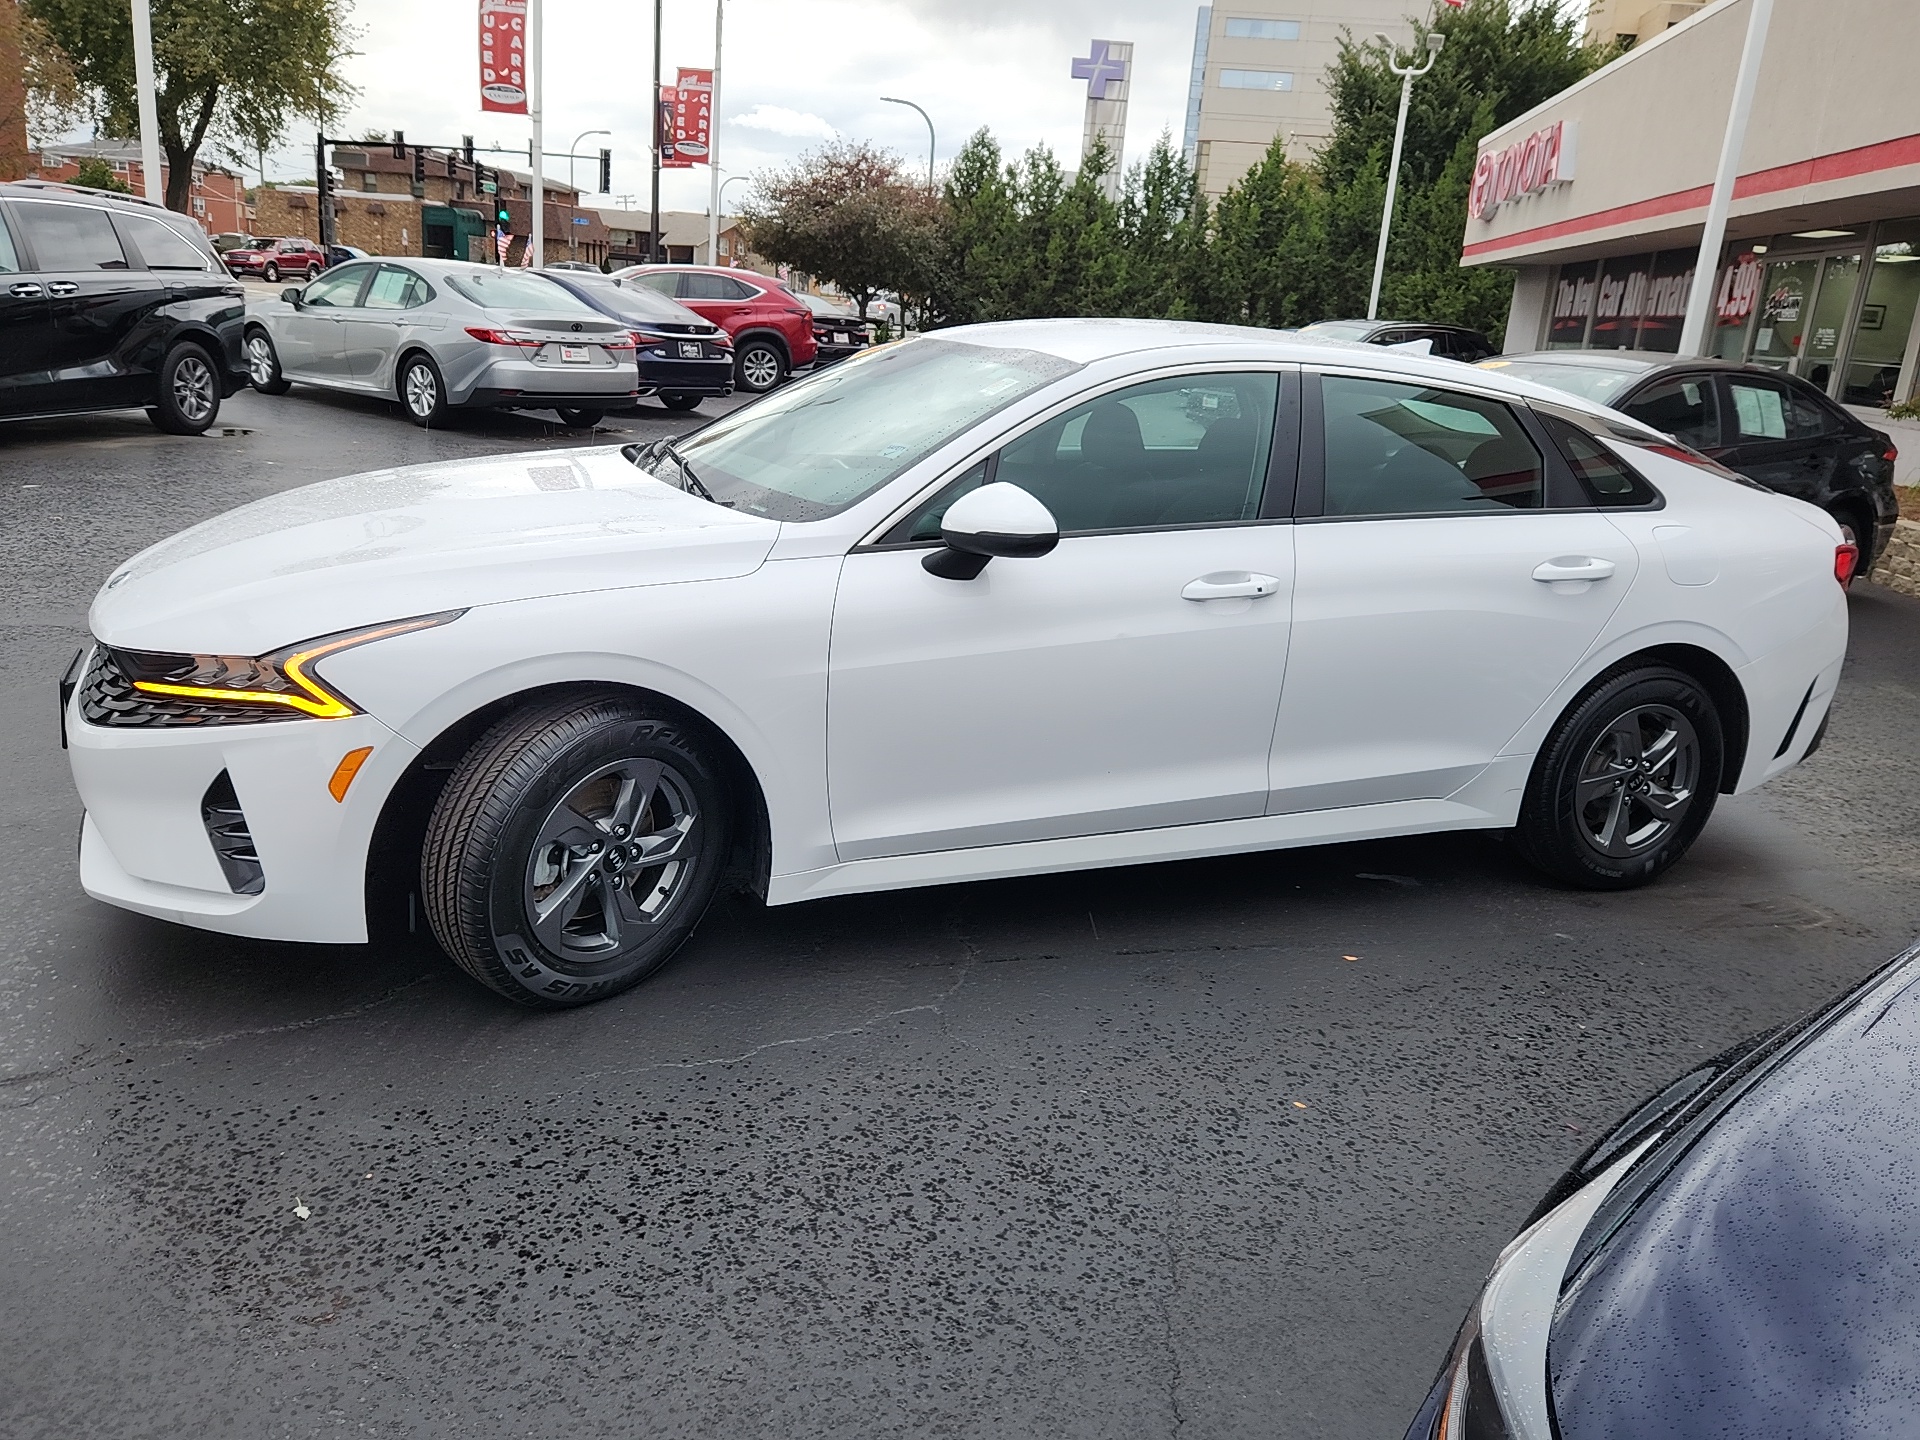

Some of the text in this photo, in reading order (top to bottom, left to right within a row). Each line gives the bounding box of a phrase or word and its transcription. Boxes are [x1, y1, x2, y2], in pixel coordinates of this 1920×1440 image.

[482, 14, 496, 82] USED
[510, 17, 524, 86] CARS
[676, 91, 688, 139] USED
[697, 93, 709, 142] CARS
[1495, 120, 1563, 203] TOYOTA
[1555, 280, 1575, 317] The
[1597, 273, 1625, 317] Car
[1629, 774, 1645, 789] KIA
[609, 848, 625, 870] KIA
